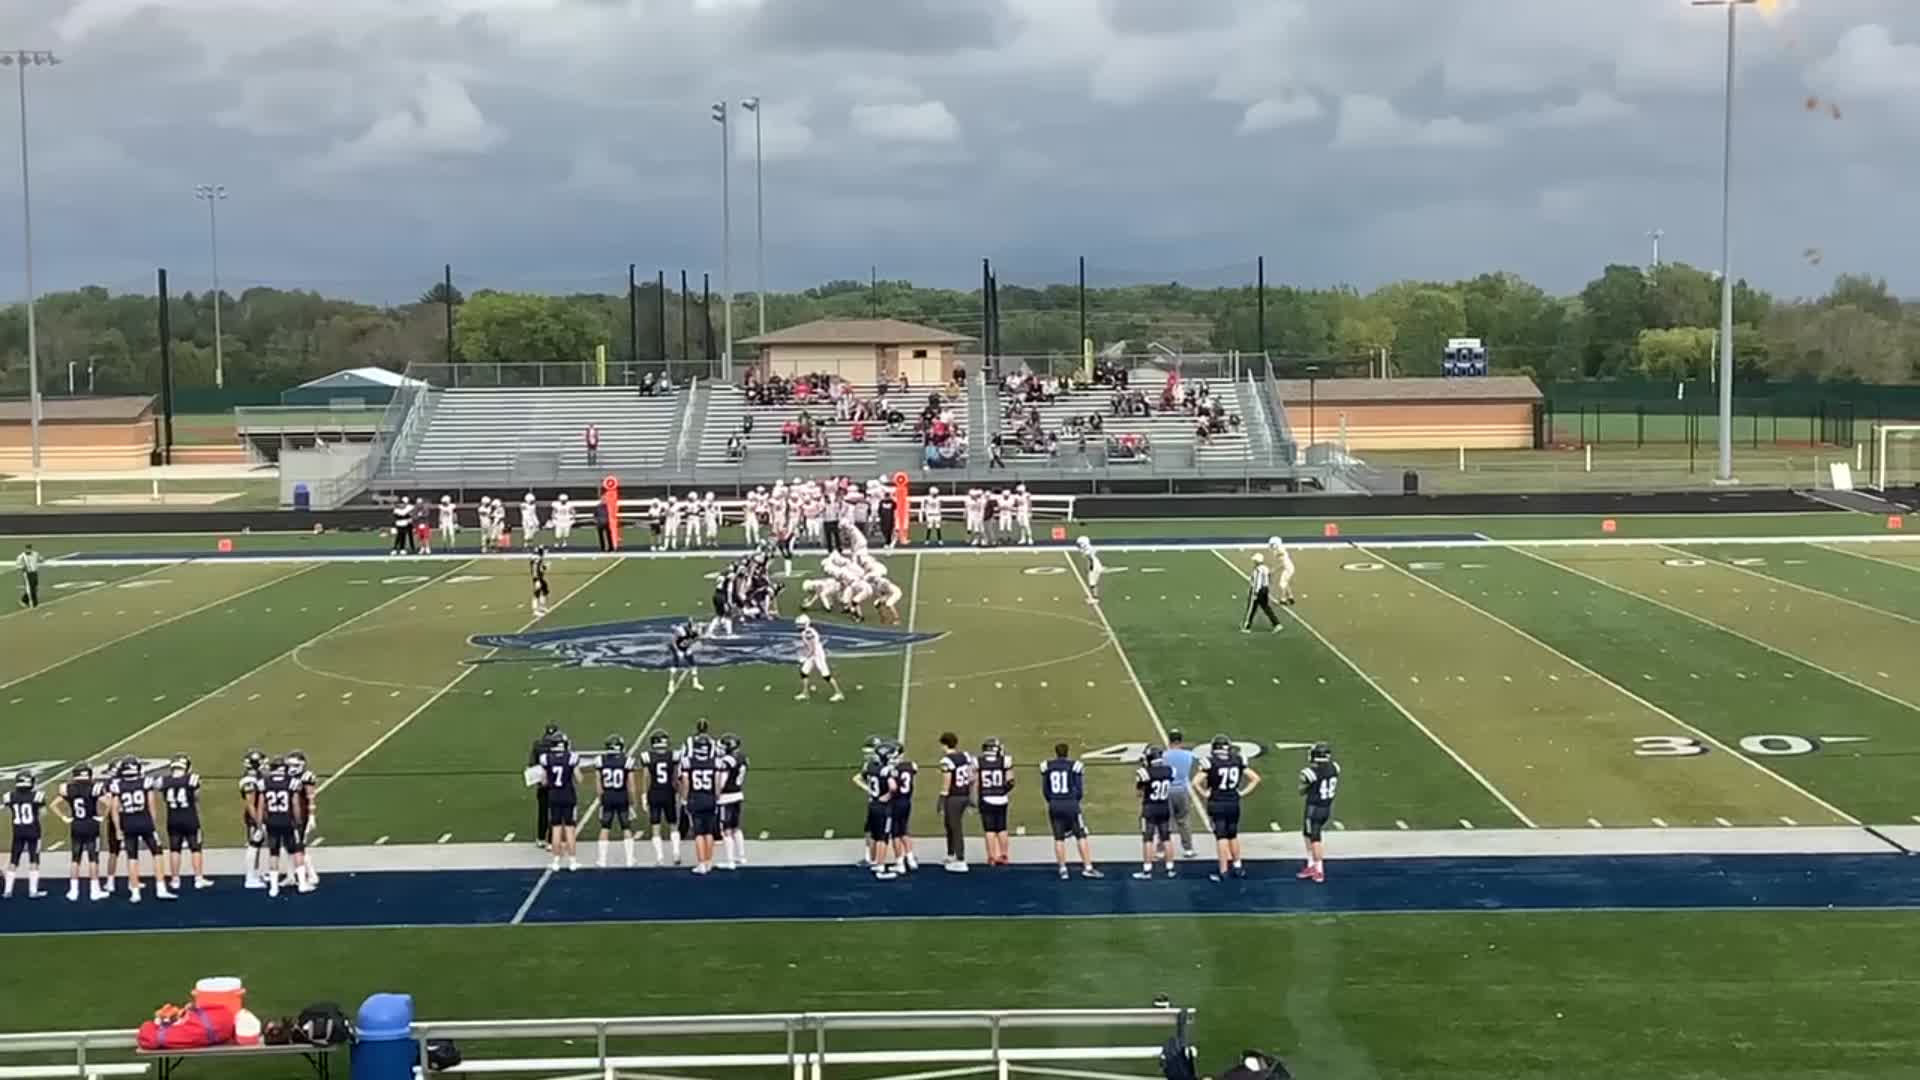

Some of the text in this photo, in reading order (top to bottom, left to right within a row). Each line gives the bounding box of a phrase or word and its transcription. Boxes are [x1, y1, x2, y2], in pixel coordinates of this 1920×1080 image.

[552, 766, 564, 787] 7
[602, 768, 625, 788] 20
[656, 762, 668, 784] 5
[692, 769, 713, 791] 65
[981, 769, 1003, 788] 50
[1049, 770, 1069, 794] 81
[1218, 767, 1240, 790] 79
[121, 789, 145, 813] 29
[166, 788, 189, 808] 44
[265, 790, 289, 812] 23
[1149, 779, 1170, 801] 30
[12, 802, 34, 825] 10
